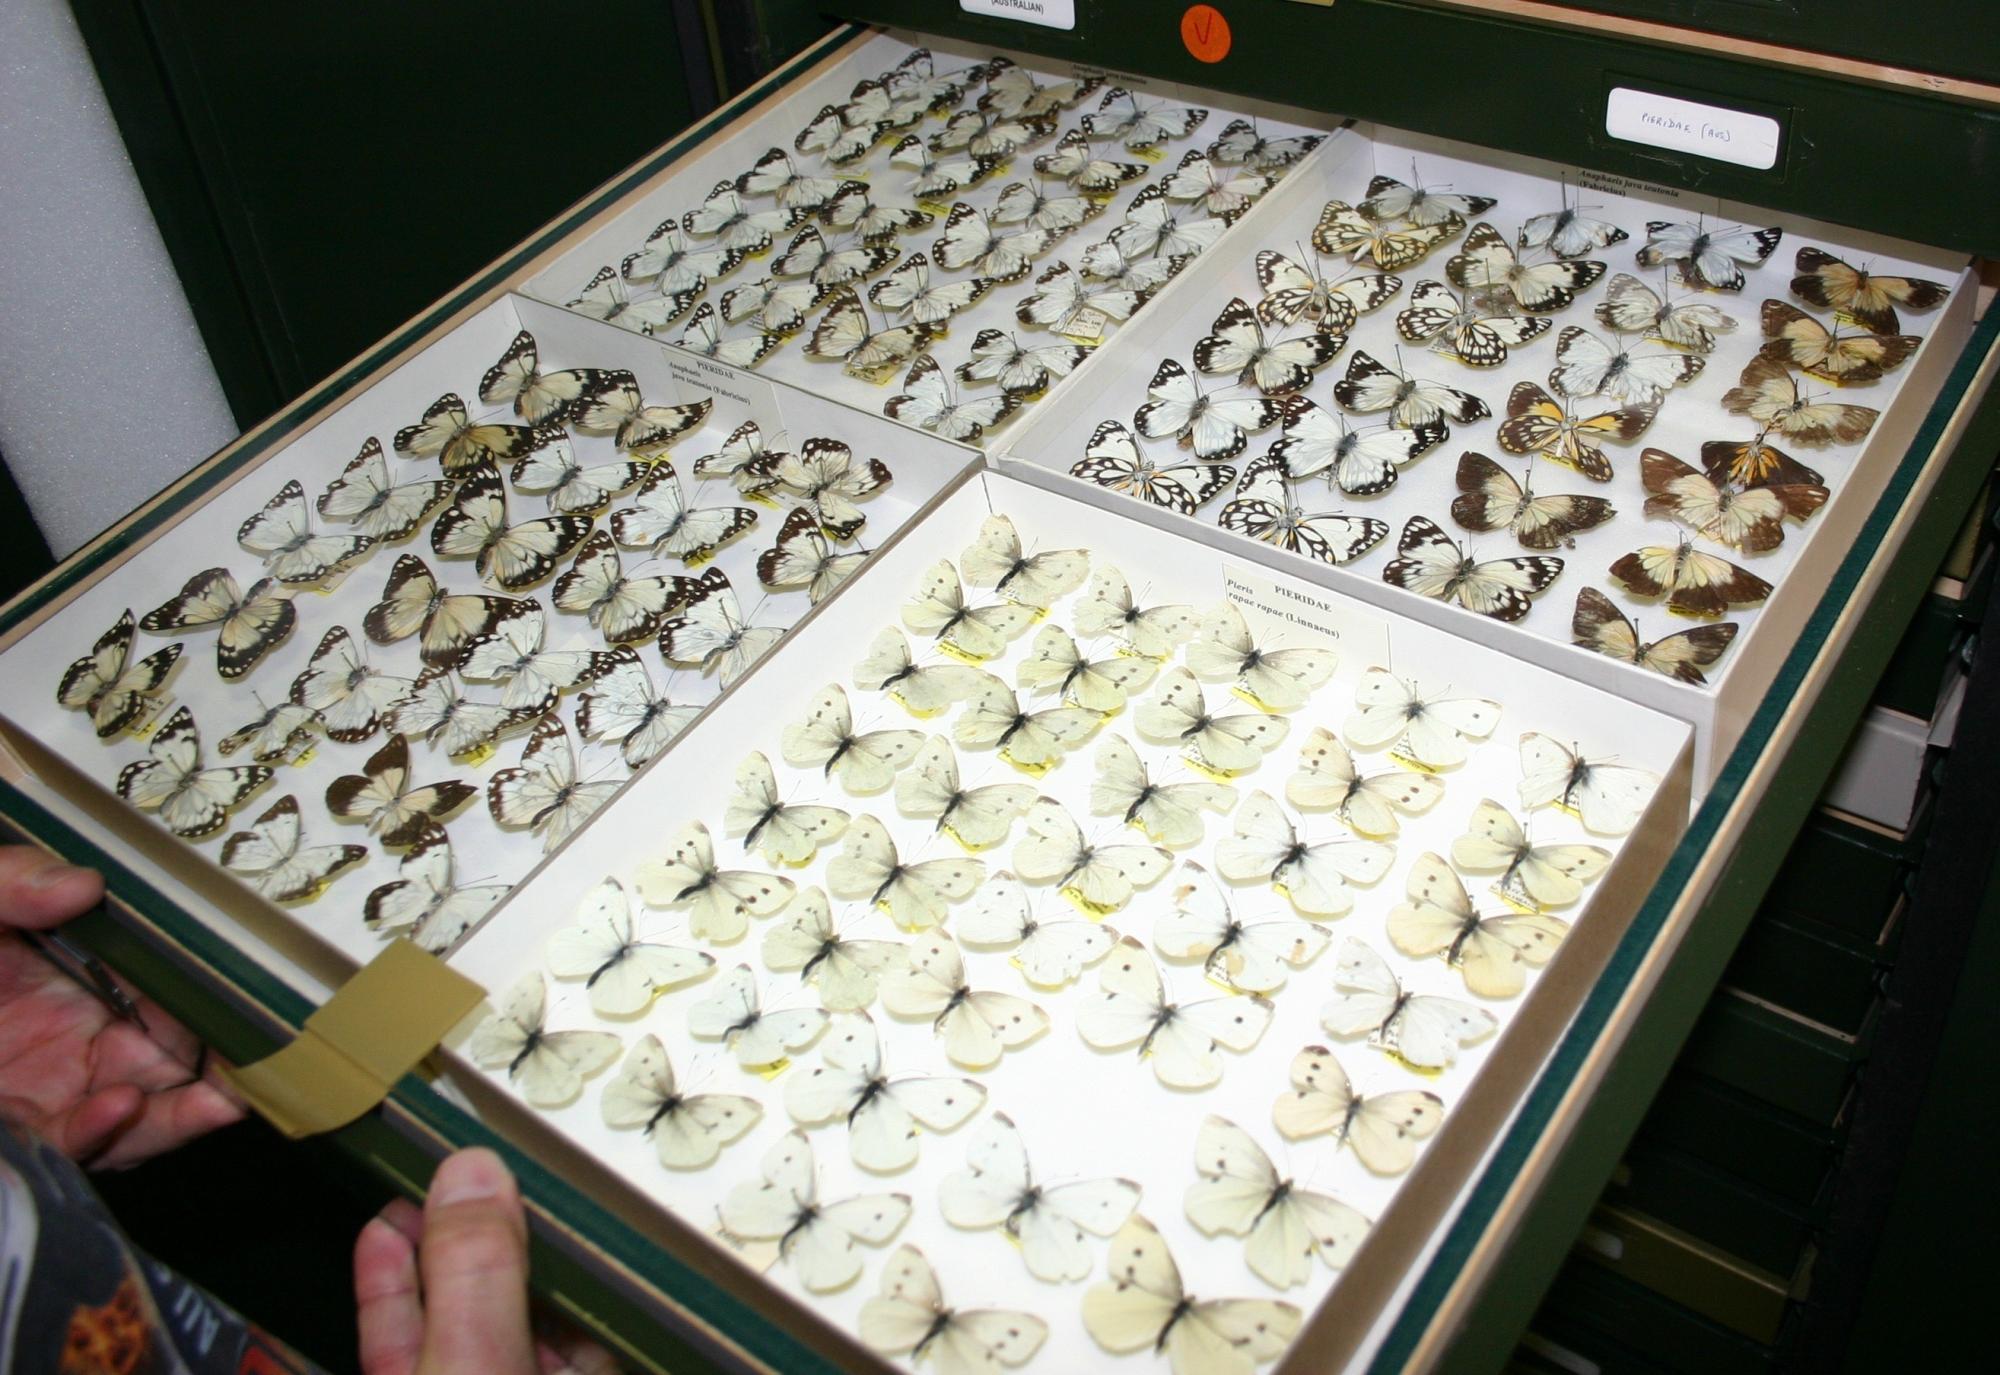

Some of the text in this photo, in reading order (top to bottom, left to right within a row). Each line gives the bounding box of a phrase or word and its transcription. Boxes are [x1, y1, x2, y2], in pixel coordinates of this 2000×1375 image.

[1641, 112, 1692, 133] PIERIDAE
[1227, 579, 1254, 595] Pieris
[1274, 585, 1332, 613] PIERIDAE
[1228, 592, 1340, 639] rapae rapae (Linnaeus)
